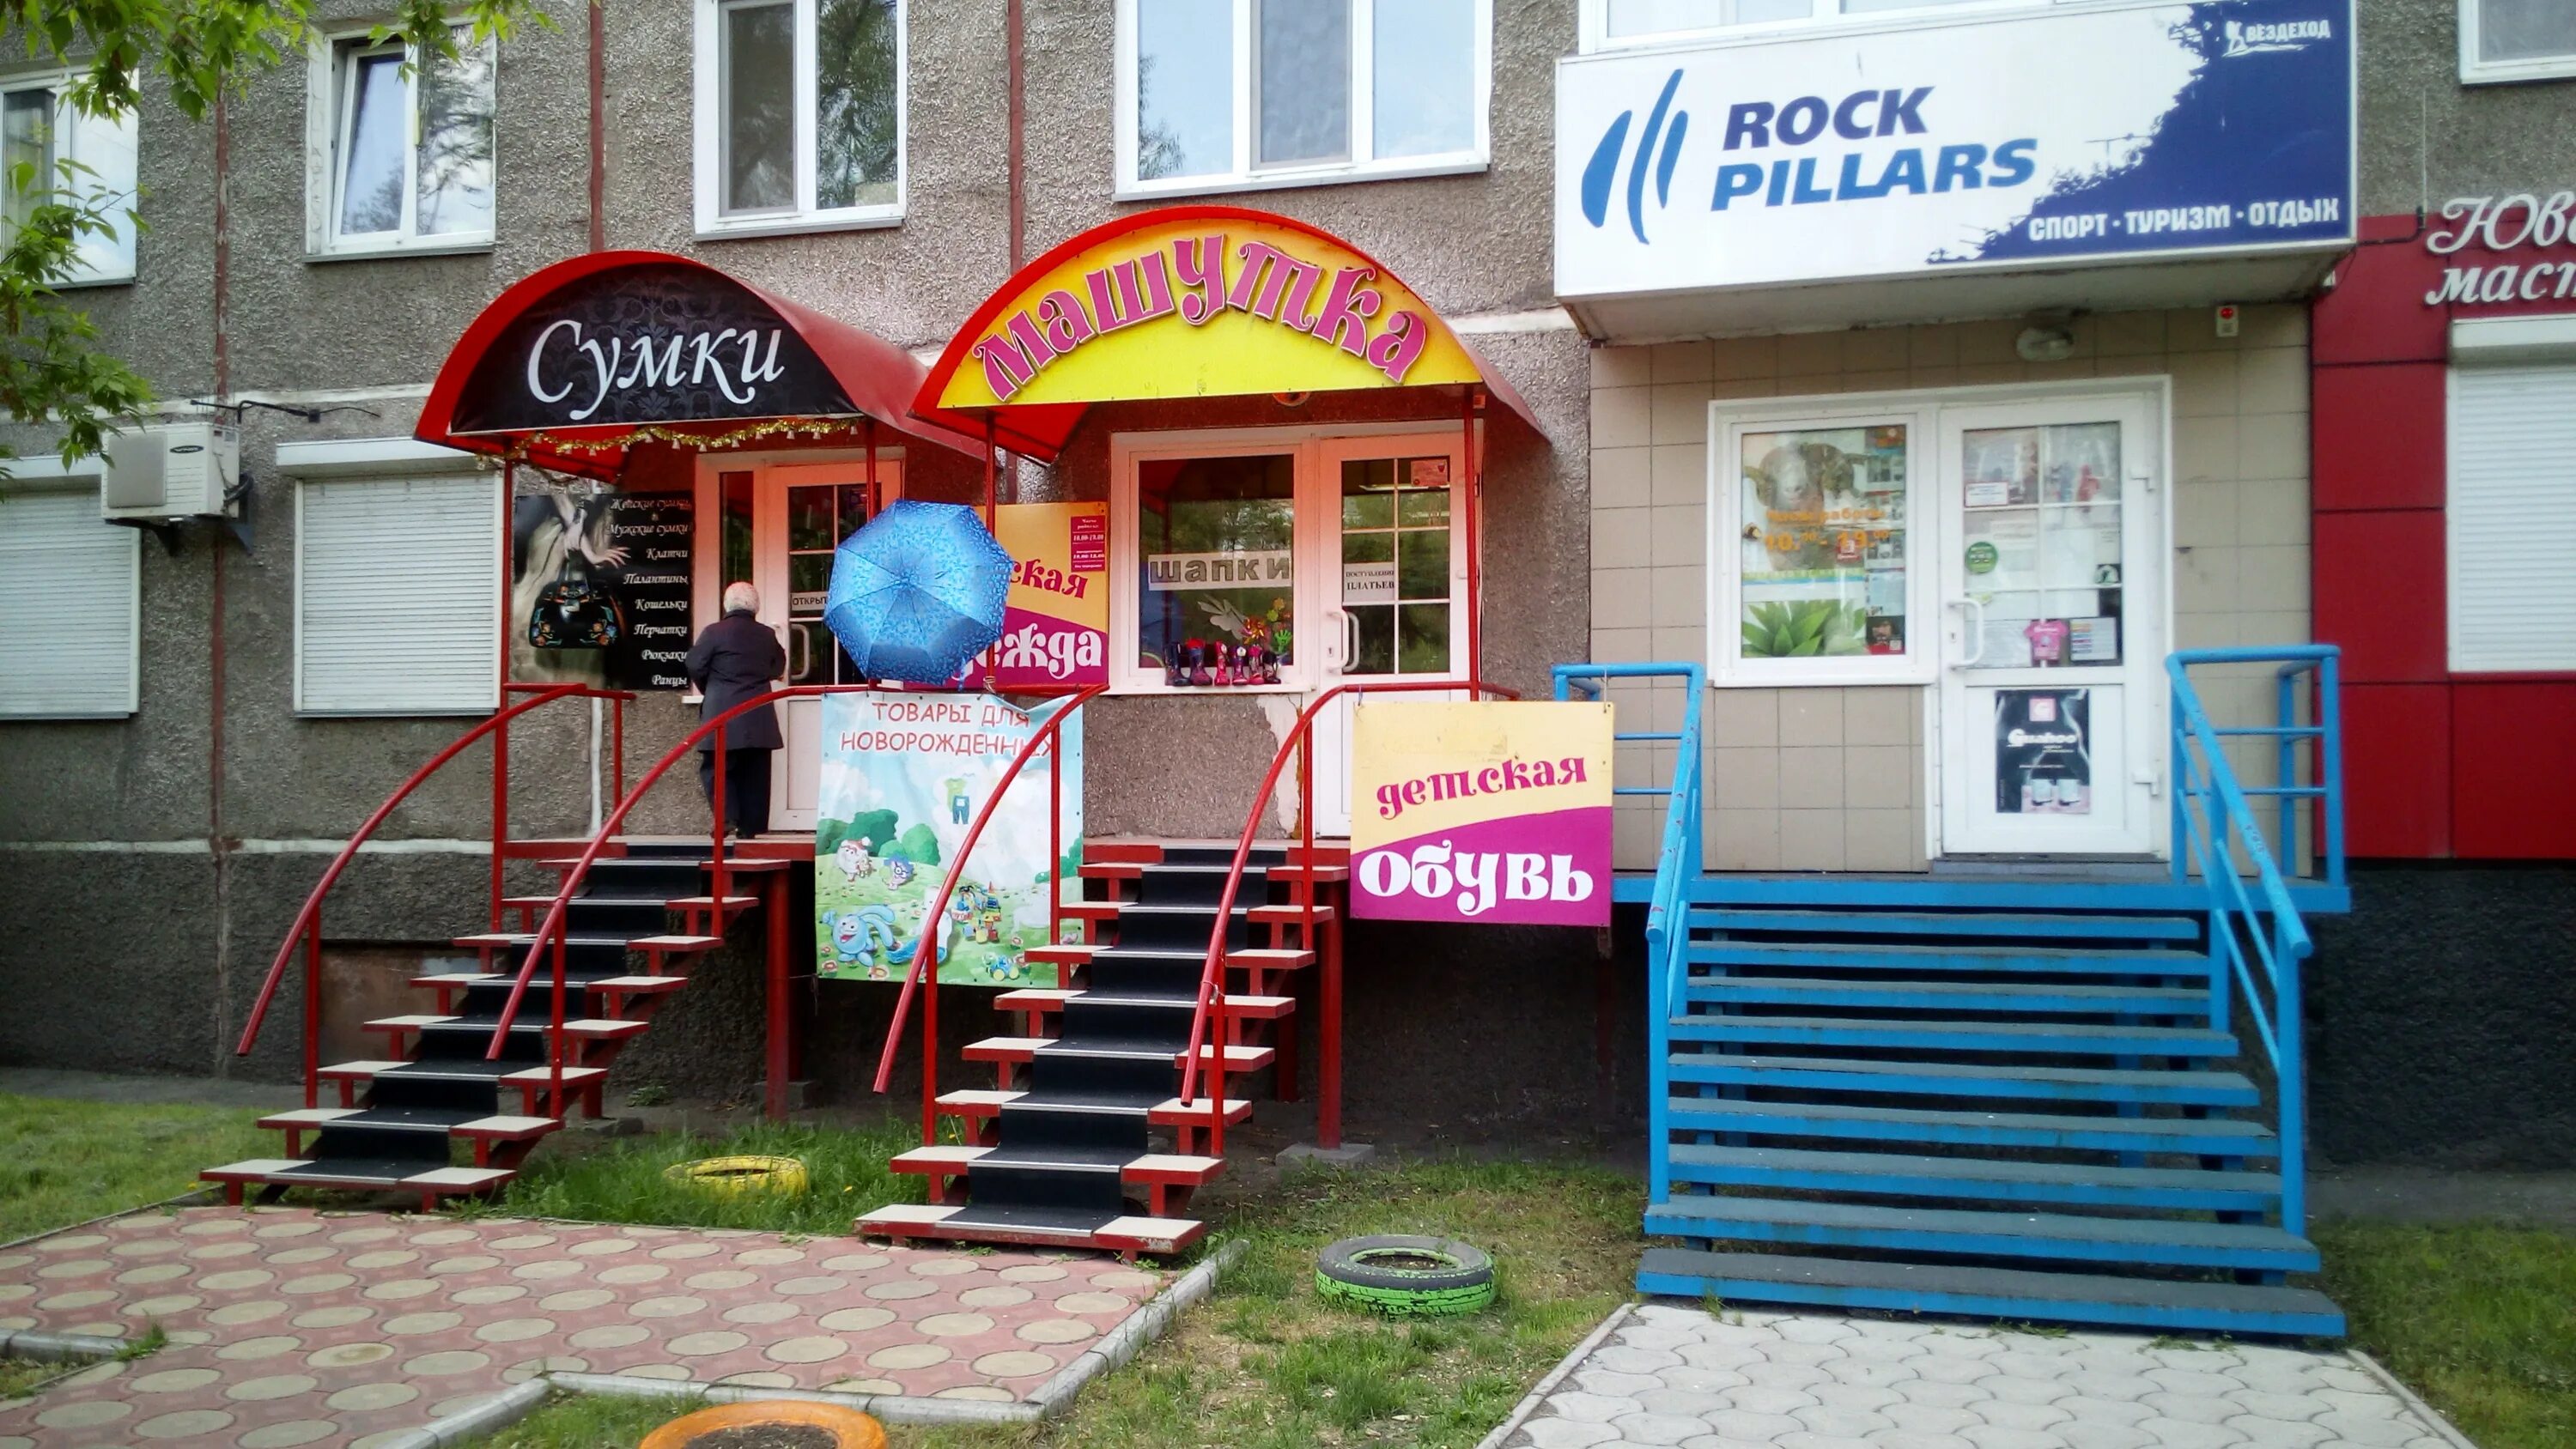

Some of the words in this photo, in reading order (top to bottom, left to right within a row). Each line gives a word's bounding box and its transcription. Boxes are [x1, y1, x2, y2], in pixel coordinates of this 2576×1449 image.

[1722, 86, 1935, 151] ROCK
[1710, 138, 2038, 211] PILLARS
[2028, 214, 2108, 241] СПОРТ
[2124, 205, 2231, 234] ТУРИЗМ
[2248, 197, 2339, 227] ОТДЫХ
[2427, 191, 2576, 254] Юв
[972, 233, 1427, 403] Машутка
[527, 319, 785, 421] Сумки
[610, 524, 654, 537] Мужские
[656, 524, 689, 536] сумки
[646, 548, 689, 560] Клатчи
[623, 573, 689, 585] Палантины
[1010, 559, 1088, 599] ская
[1150, 557, 1290, 584] шапки
[1346, 580, 1394, 591] ПЛАТЬЕВ
[635, 598, 688, 611] Кошельки
[792, 597, 828, 605] ОТКРЫТ
[633, 624, 688, 638] Перчатки
[641, 650, 688, 662] Рюкзаки
[652, 675, 690, 688] Ранцы
[872, 702, 971, 724] ТОВАРЫ
[981, 705, 1030, 728] ДЛЯ
[1376, 757, 1587, 820] детская
[1358, 840, 1594, 916] Обувь
